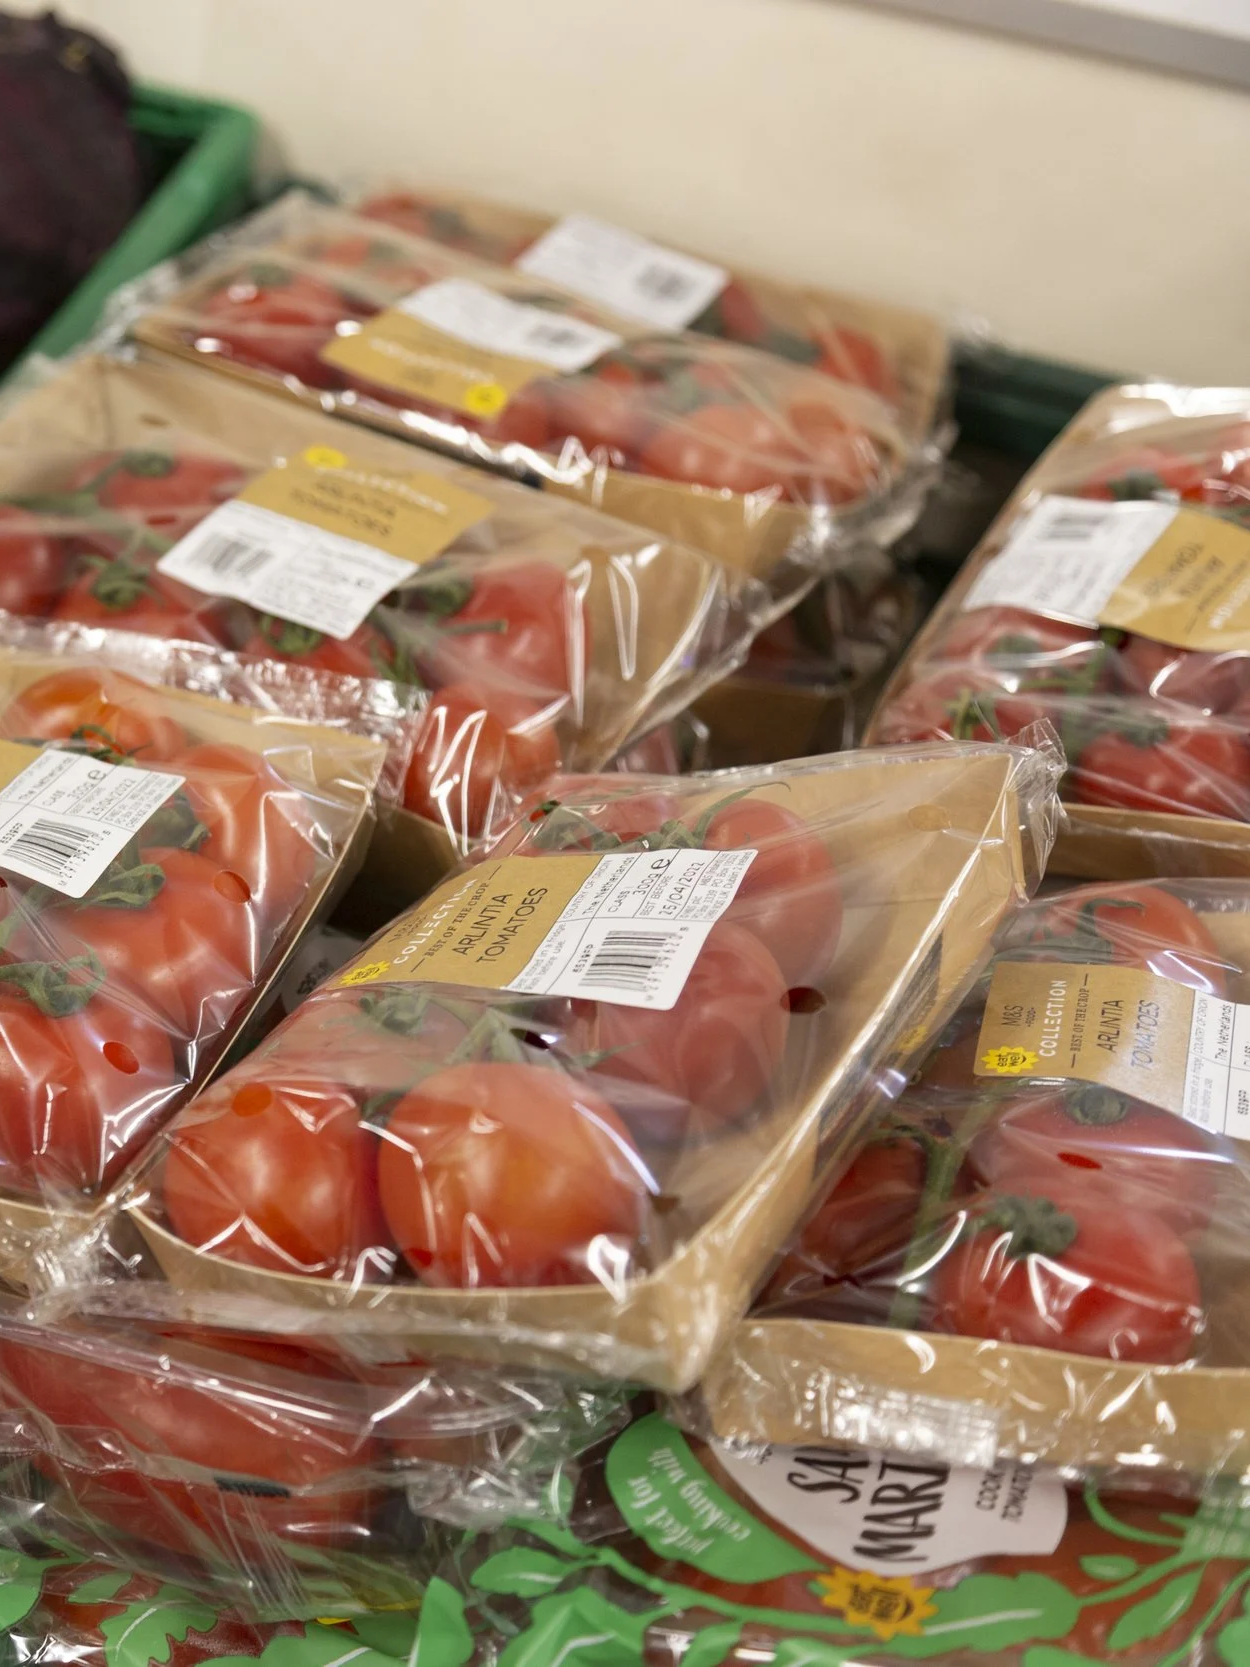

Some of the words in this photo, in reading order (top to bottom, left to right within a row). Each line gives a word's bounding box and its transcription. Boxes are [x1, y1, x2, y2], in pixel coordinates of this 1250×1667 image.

[582, 901, 600, 915] The
[595, 856, 635, 899] Netherlands
[608, 890, 631, 913] CLASS
[632, 872, 661, 896] 300g
[658, 862, 705, 915] 25/04/2022
[424, 937, 447, 957] BEST
[443, 925, 457, 939] OF
[454, 908, 471, 925] THE
[468, 882, 489, 909] CROP
[452, 893, 513, 956] ARLINTIA
[476, 887, 548, 963] TOMATOES
[1001, 1003, 1023, 1026] M&S
[1038, 980, 1067, 1057] COLLECTION
[1074, 1006, 1088, 1022] THE
[1078, 988, 1089, 1008] CROP
[1070, 1035, 1084, 1052] BEST
[1073, 1020, 1084, 1033] OF
[1096, 999, 1124, 1053] ARLINTIA
[1131, 999, 1160, 1071] TOMATOES
[1214, 1047, 1228, 1060] The
[646, 1447, 687, 1485] with
[975, 1462, 1006, 1512] COOK
[626, 1475, 662, 1510] for
[678, 1480, 751, 1543] cooking
[643, 1505, 715, 1556] perfect
